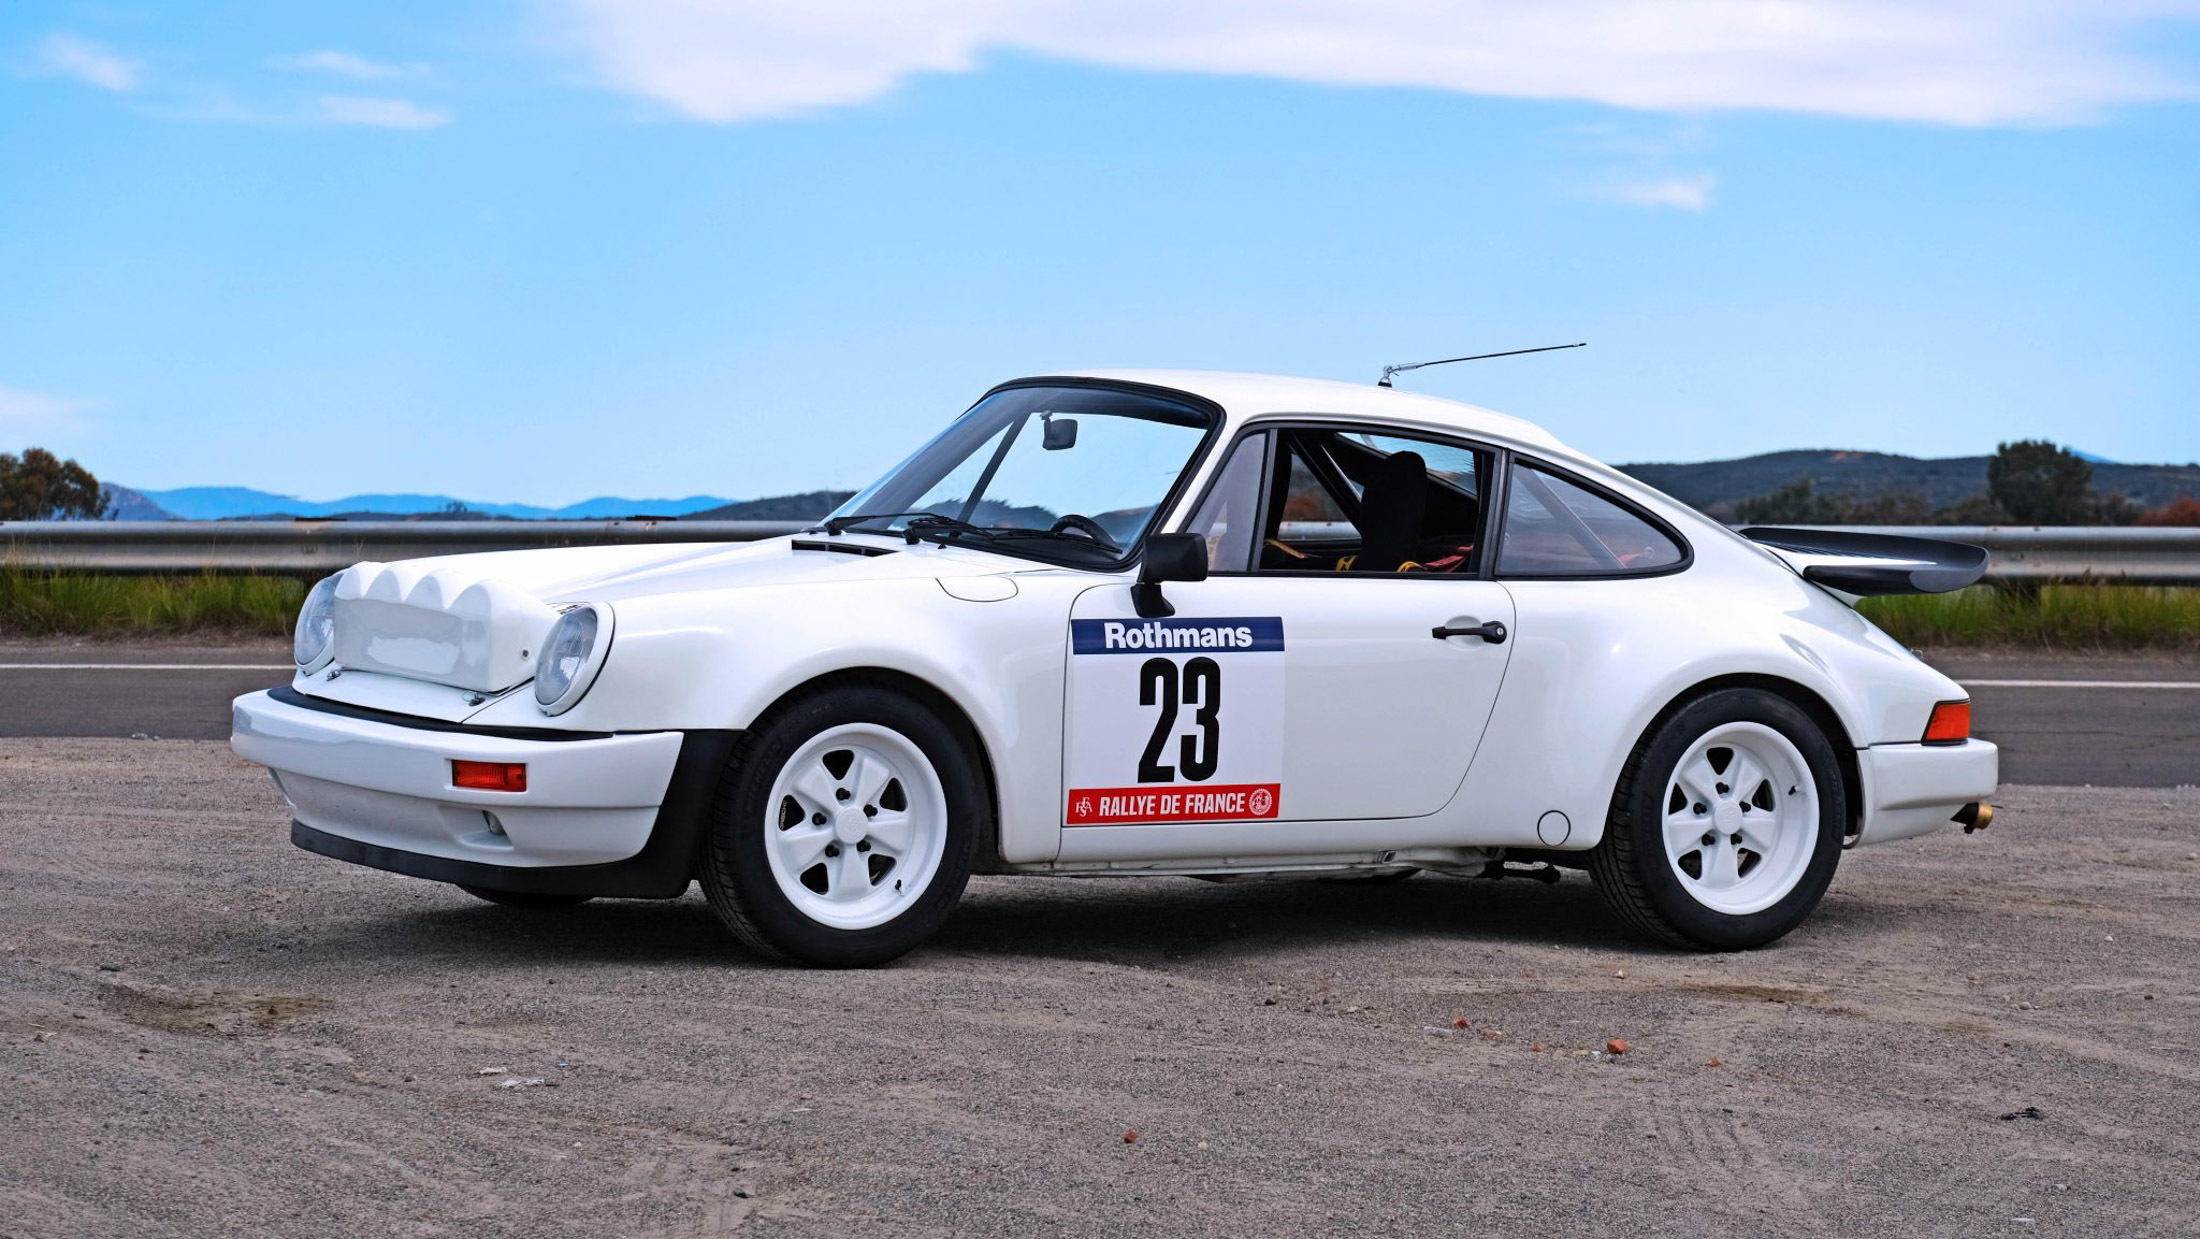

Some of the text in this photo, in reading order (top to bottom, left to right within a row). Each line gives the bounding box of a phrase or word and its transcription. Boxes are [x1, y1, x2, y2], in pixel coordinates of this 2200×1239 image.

[1104, 622, 1253, 648] Rothmans
[1138, 657, 1220, 783] 23
[1099, 793, 1245, 816] RALLYE DE FRANCE
